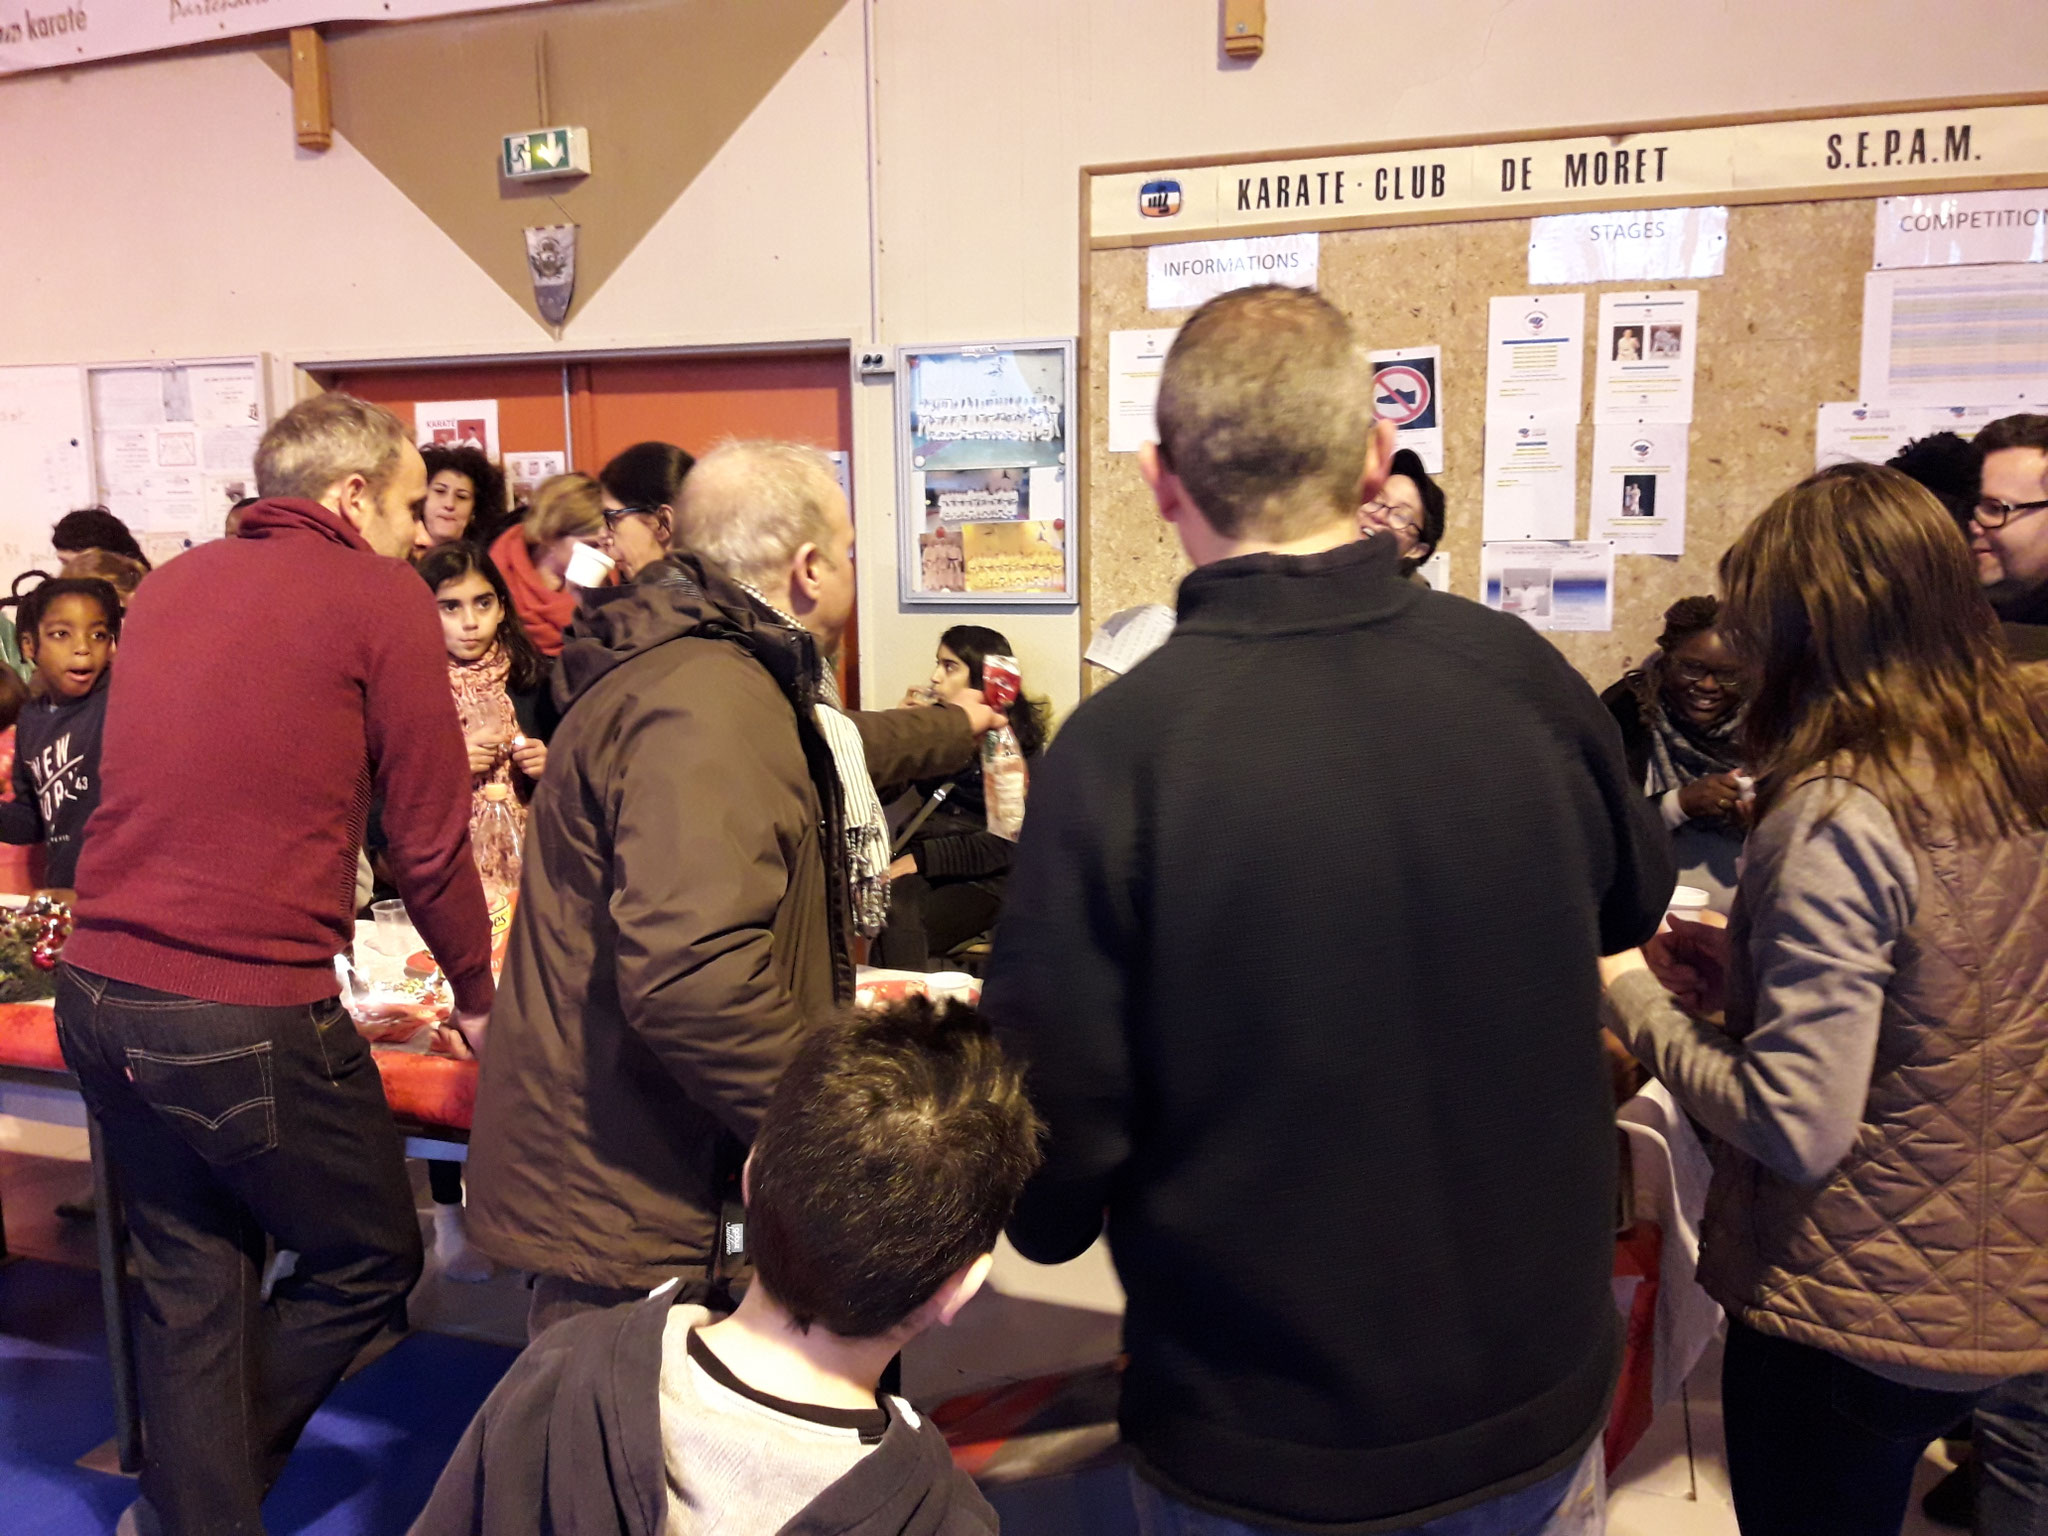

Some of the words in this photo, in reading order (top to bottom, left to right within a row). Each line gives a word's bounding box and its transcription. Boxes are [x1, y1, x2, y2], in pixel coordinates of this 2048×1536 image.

[1501, 157, 1532, 192] DE
[1565, 147, 1668, 188] MORET
[1826, 125, 1982, 169] S.E.P.A.M.
[1590, 222, 1665, 241] STAGES
[1164, 252, 1299, 277] INFORMATIONS
